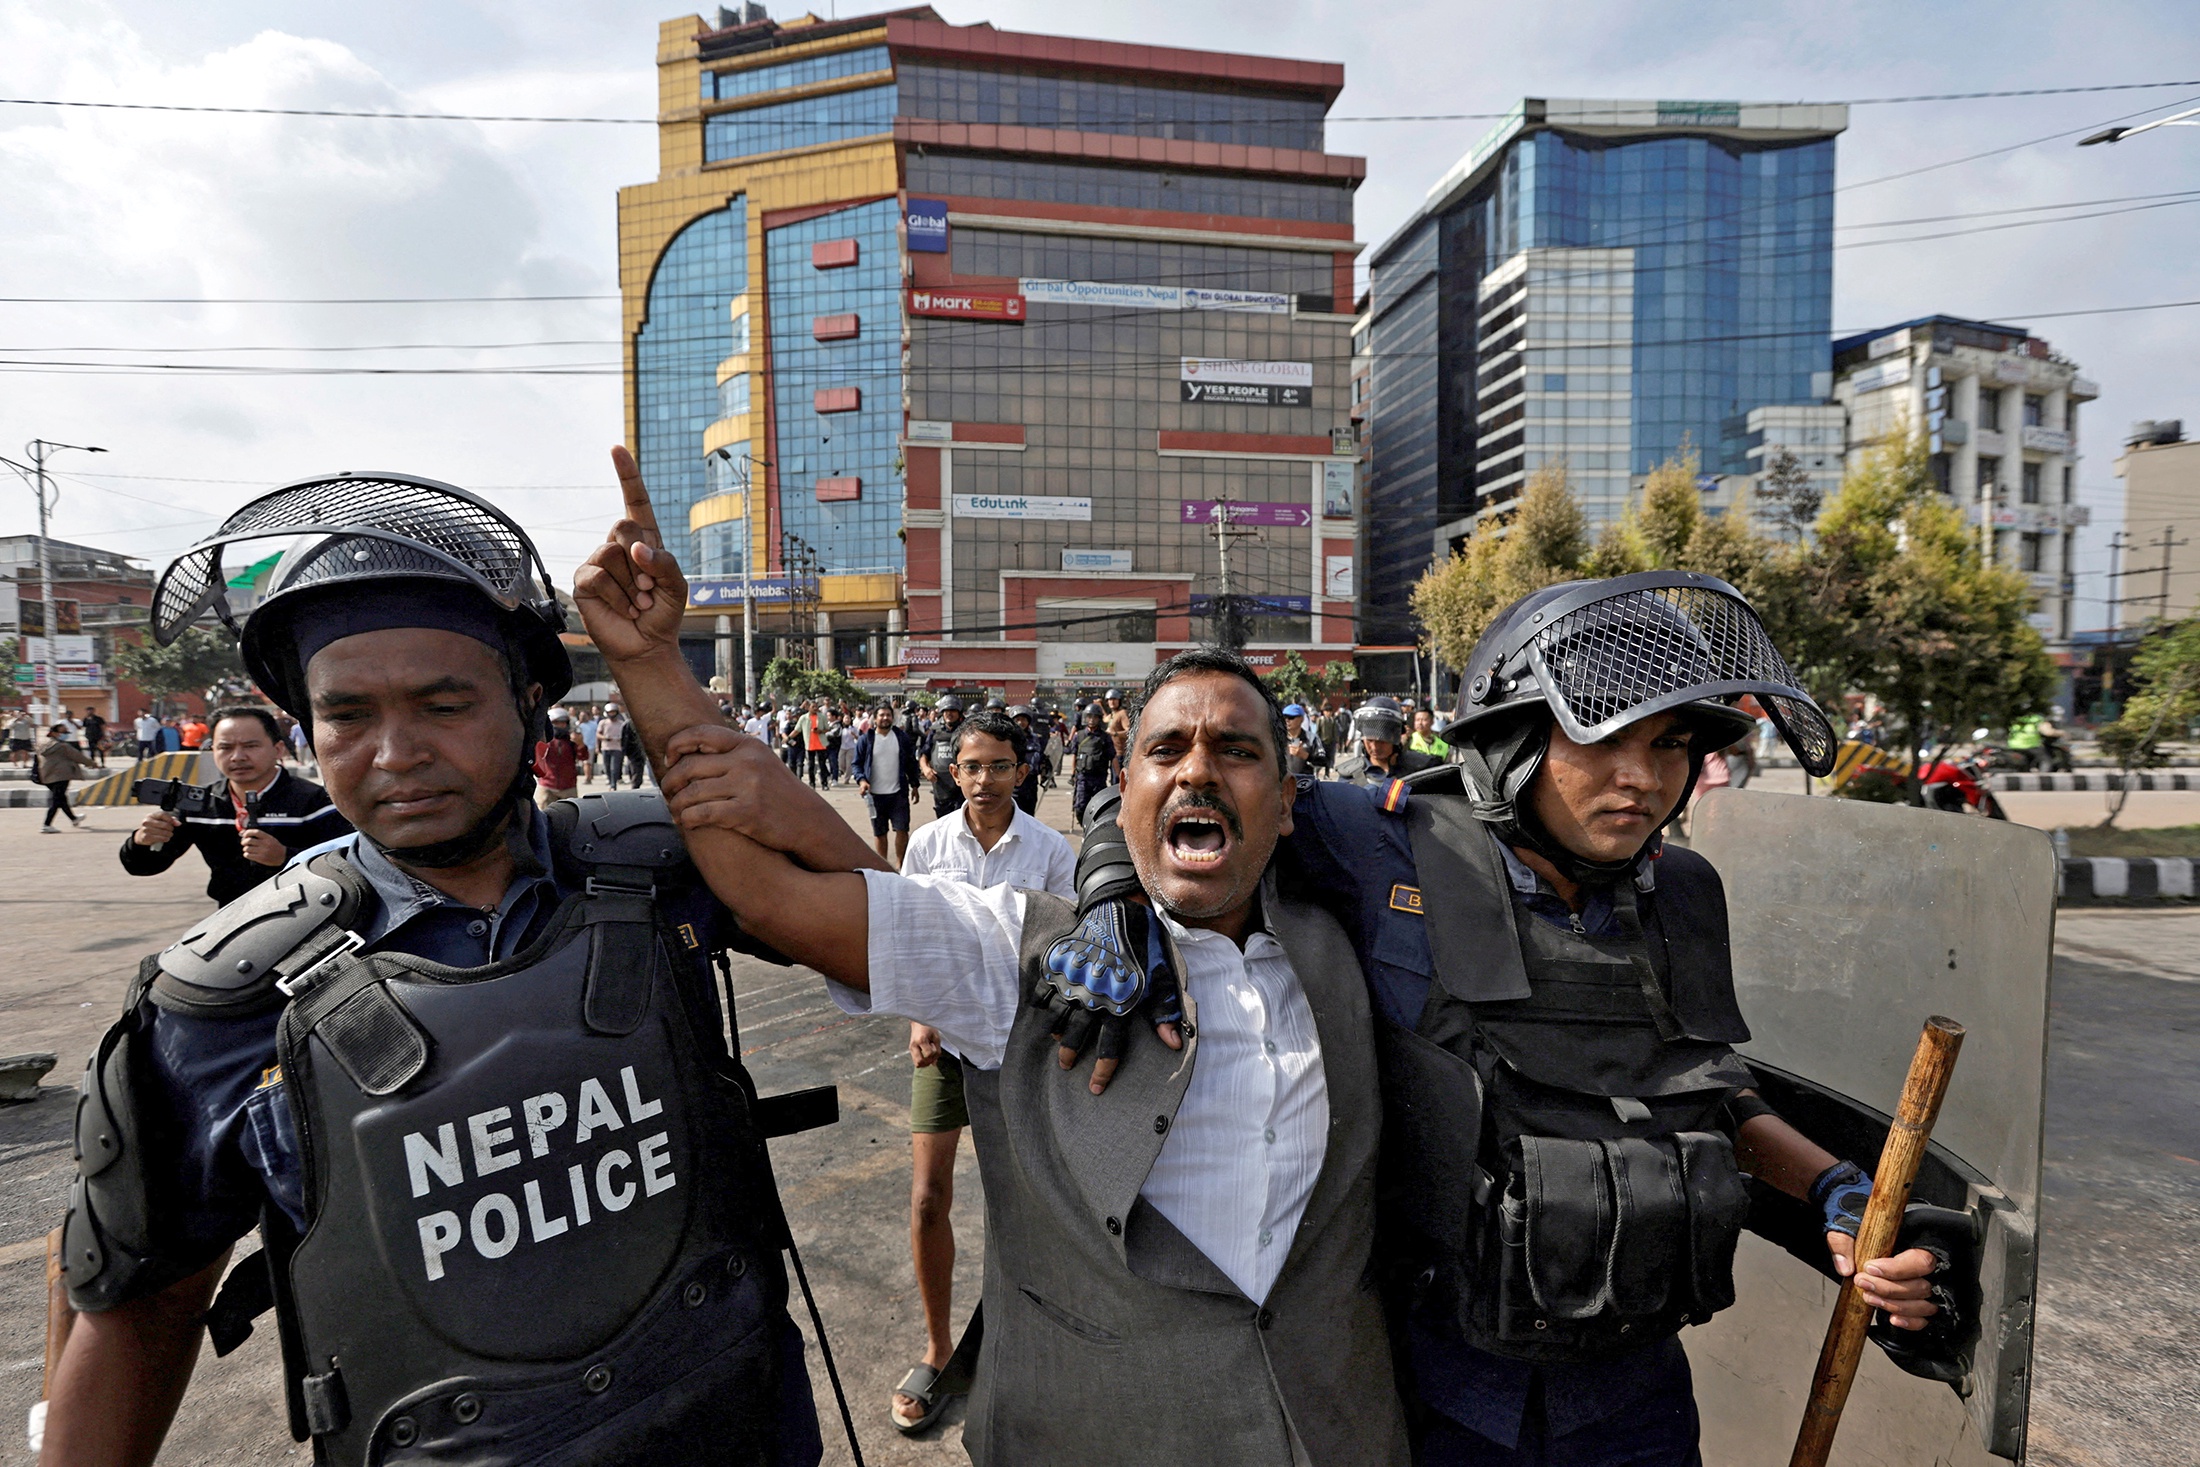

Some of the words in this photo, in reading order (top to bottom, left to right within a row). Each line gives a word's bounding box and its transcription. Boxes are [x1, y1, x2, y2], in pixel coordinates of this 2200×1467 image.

[1066, 281, 1144, 298] Opportunities
[1146, 287, 1178, 301] Nepal
[1214, 293, 1243, 302] GLOBAL
[1203, 361, 1250, 373] SHINE
[1251, 362, 1310, 376] GLOBAL
[1204, 384, 1226, 394] YES
[1228, 386, 1269, 396] PEOPLE
[970, 496, 1028, 509] EduLink
[1244, 655, 1274, 665] COFFEE
[404, 1065, 664, 1198] NEPAL
[416, 1132, 677, 1281] POLICE
